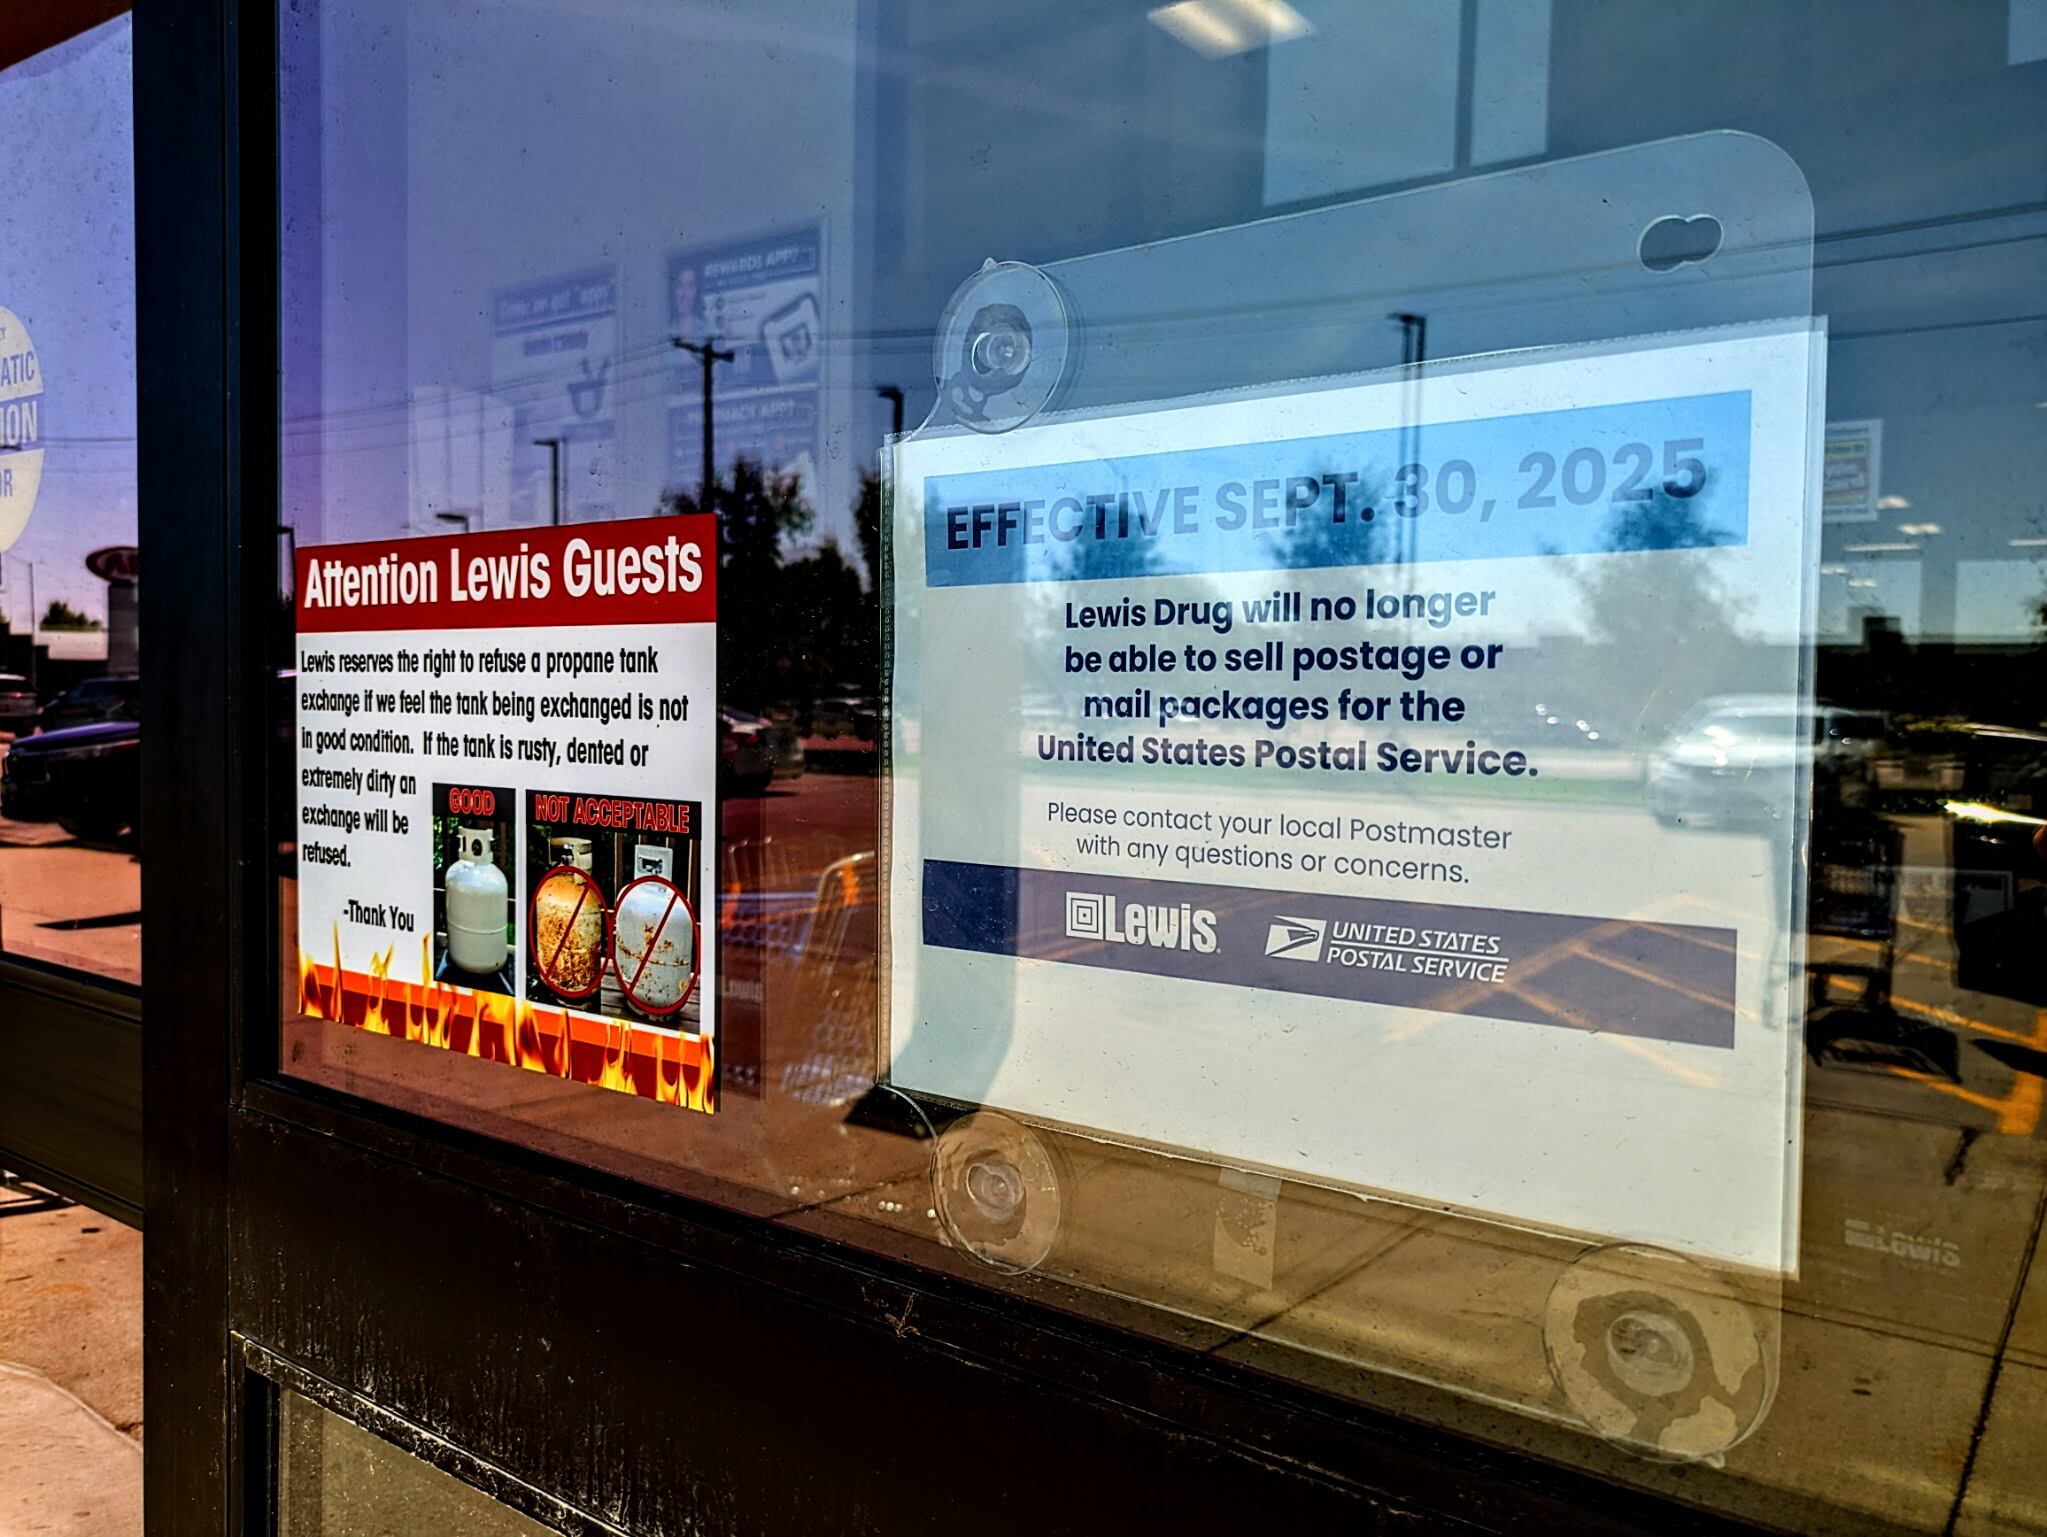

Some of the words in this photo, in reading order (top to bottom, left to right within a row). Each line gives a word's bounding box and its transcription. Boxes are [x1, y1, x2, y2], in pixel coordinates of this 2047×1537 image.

[946, 486, 1199, 551] EFFECTIVE
[1214, 470, 1375, 531] SEPT.
[1394, 457, 1498, 522] 30,
[1517, 437, 1707, 509] 2025
[304, 553, 438, 608] Attention
[450, 543, 551, 602] Lewis
[563, 534, 703, 598] Guests
[1065, 597, 1146, 629] Lewis
[1154, 595, 1232, 634] Drug
[1241, 591, 1300, 624] will
[1311, 594, 1356, 621] no
[1366, 588, 1496, 628] longer
[301, 650, 335, 673] Lewis
[339, 652, 393, 673] reserves
[397, 649, 419, 673] the
[423, 648, 456, 678] right
[460, 649, 474, 673] to
[479, 648, 526, 673] refuse
[531, 652, 541, 673] a
[547, 650, 614, 679] propane
[620, 646, 658, 673] tank
[1064, 645, 1101, 673] be
[1108, 643, 1176, 673] able
[1184, 645, 1217, 672] to
[1224, 641, 1284, 672] sell
[1293, 640, 1451, 681] postage
[1460, 642, 1503, 671] or
[301, 689, 360, 717] exchange
[364, 689, 373, 713] if
[376, 693, 396, 713] we
[400, 690, 425, 714] feel
[429, 690, 452, 714] the
[457, 690, 488, 715] tank
[493, 691, 535, 722] being
[541, 692, 631, 725] exchanged
[638, 693, 653, 720] is
[659, 695, 689, 721] not
[1084, 689, 1150, 718] mail
[1159, 689, 1329, 730] packages
[1338, 688, 1392, 721] for
[1400, 690, 1466, 722] the
[301, 727, 313, 749] in
[316, 728, 346, 754] good
[350, 729, 414, 754] condition.
[423, 731, 434, 756] If
[437, 732, 459, 757] the
[463, 733, 496, 759] tank
[500, 734, 513, 760] is
[518, 737, 561, 767] rusty,
[568, 737, 624, 766] dented
[630, 745, 649, 767] or
[1037, 733, 1134, 765] United
[1141, 735, 1246, 768] States
[1254, 738, 1366, 771] Postal
[1376, 740, 1539, 778] Service.
[302, 767, 363, 796] extremely
[367, 769, 396, 798] dirty
[400, 775, 416, 795] an
[450, 787, 496, 816] GOOD
[302, 804, 361, 834] exchange
[365, 808, 388, 833] will
[392, 810, 409, 835] be
[535, 794, 570, 822] NOT
[573, 797, 690, 834] ACCEPTABLE
[1047, 802, 1117, 826] Please
[1123, 808, 1212, 832] contact
[1218, 815, 1272, 839] your
[1279, 814, 1341, 839] local
[1350, 818, 1513, 850] Postmaster
[302, 841, 351, 867] refused.
[1076, 833, 1123, 858] with
[1127, 840, 1169, 866] any
[1175, 844, 1293, 872] questions
[1300, 853, 1327, 872] or
[1334, 855, 1470, 884] concerns.
[343, 898, 387, 928] -Thank
[389, 905, 414, 932] You
[1105, 895, 1218, 954] Lewis
[1333, 921, 1416, 946] UNITED
[1419, 930, 1502, 955] STATES
[1327, 947, 1407, 972] POSTAL
[1410, 957, 1509, 983] SERVICE
